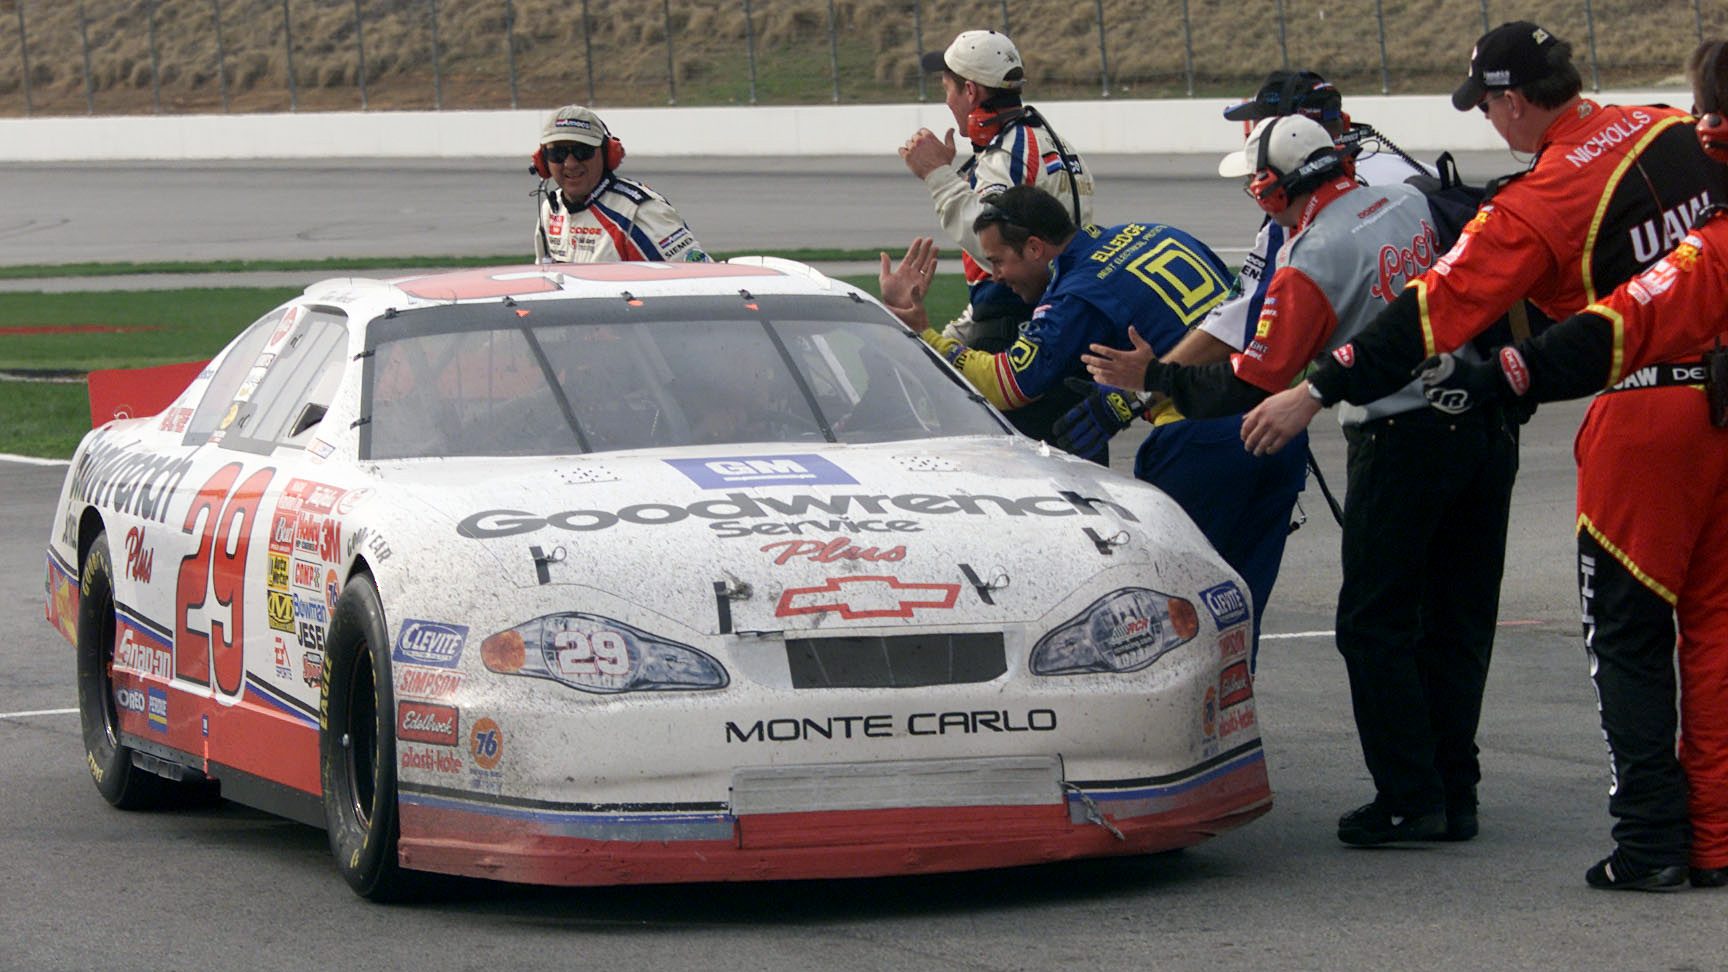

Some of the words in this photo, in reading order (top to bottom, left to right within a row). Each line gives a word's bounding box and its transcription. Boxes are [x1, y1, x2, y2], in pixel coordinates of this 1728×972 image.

[1565, 110, 1651, 168] NICHOLLS
[1091, 221, 1147, 264] ELLEDGE
[1370, 218, 1441, 304] Coor
[1144, 249, 1216, 309] D
[706, 459, 809, 476] GM
[456, 490, 1141, 539] Goodwrench
[708, 517, 924, 538] Service
[125, 525, 155, 584] Plus
[320, 518, 342, 564] 3M
[759, 536, 907, 566] Plus
[174, 461, 278, 697] 29
[293, 592, 327, 624] Bowman
[118, 628, 172, 681] Snap-on
[402, 623, 459, 655] CLEVITE
[554, 630, 629, 676] 29
[401, 670, 462, 697] SIMPSON
[403, 710, 453, 736] Edelbrock
[725, 714, 893, 744] MONTE
[907, 708, 1057, 736] CARLO
[401, 746, 463, 774] plasti-kote
[475, 730, 498, 757] 76
